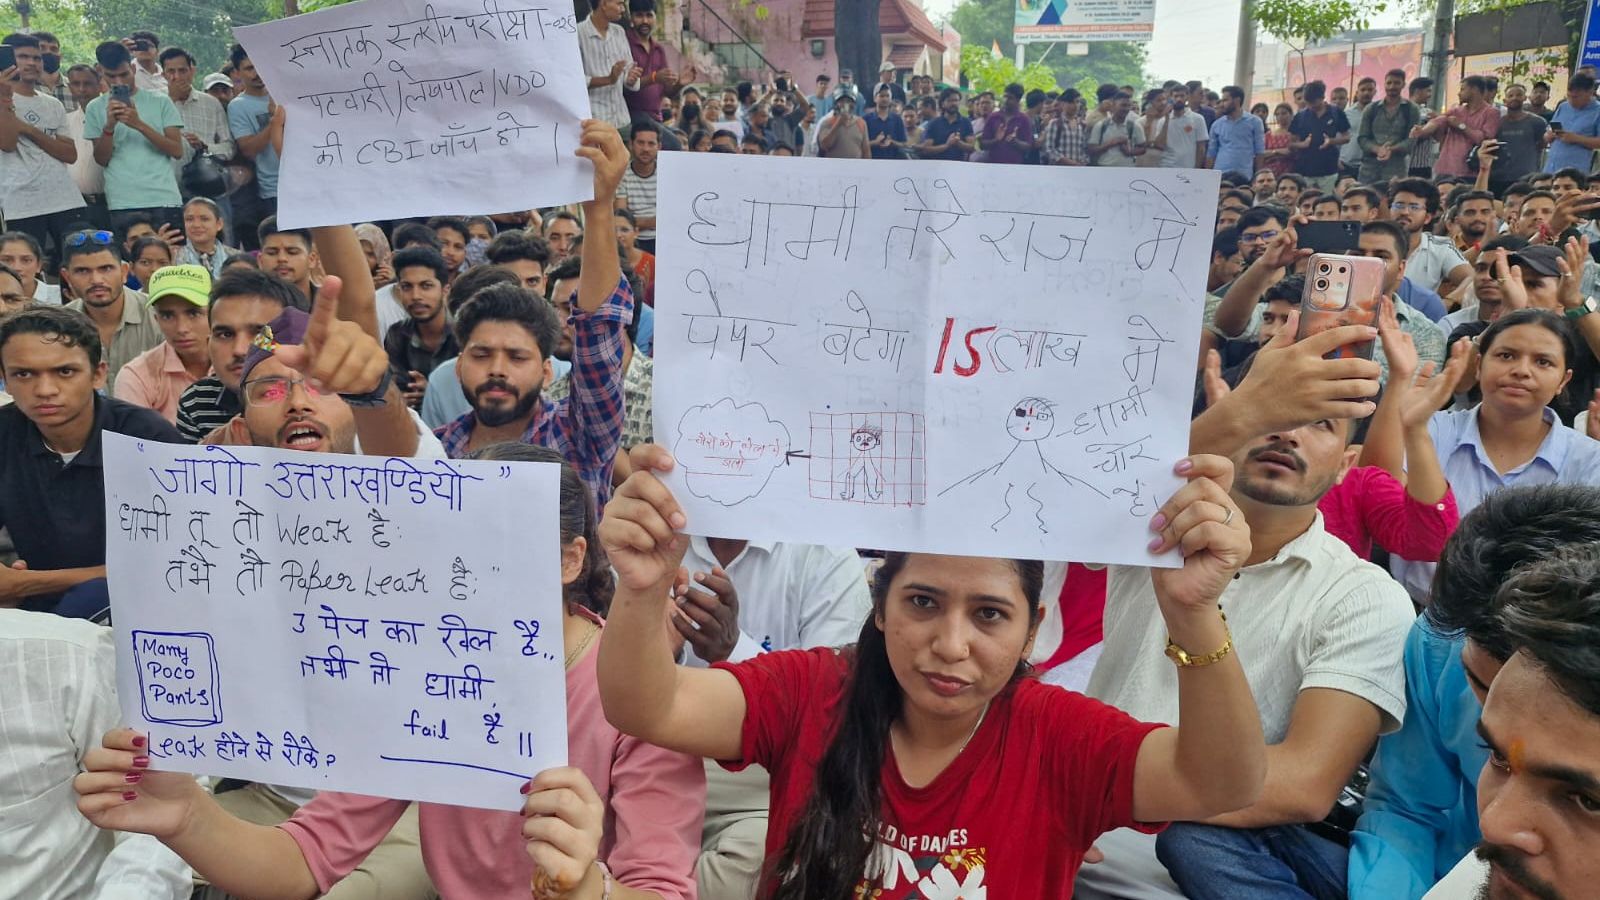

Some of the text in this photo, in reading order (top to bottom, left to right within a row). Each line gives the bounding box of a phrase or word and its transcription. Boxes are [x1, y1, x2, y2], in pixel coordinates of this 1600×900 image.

[312, 131, 344, 167] की
[356, 139, 425, 165] CBI
[687, 184, 860, 270] धामी
[884, 176, 971, 270] तेरे
[979, 208, 1094, 272] राज
[680, 268, 798, 366] पेपर
[822, 288, 911, 374] बटेगा
[188, 510, 222, 549] तू
[232, 499, 265, 546] तो
[380, 619, 426, 645] का
[300, 645, 361, 681] तभी
[369, 652, 401, 686] तो
[148, 684, 210, 706] Pants
[403, 709, 450, 741] fail
[214, 731, 250, 761] होने
[255, 731, 274, 762] से
[900, 833, 919, 852] OF
